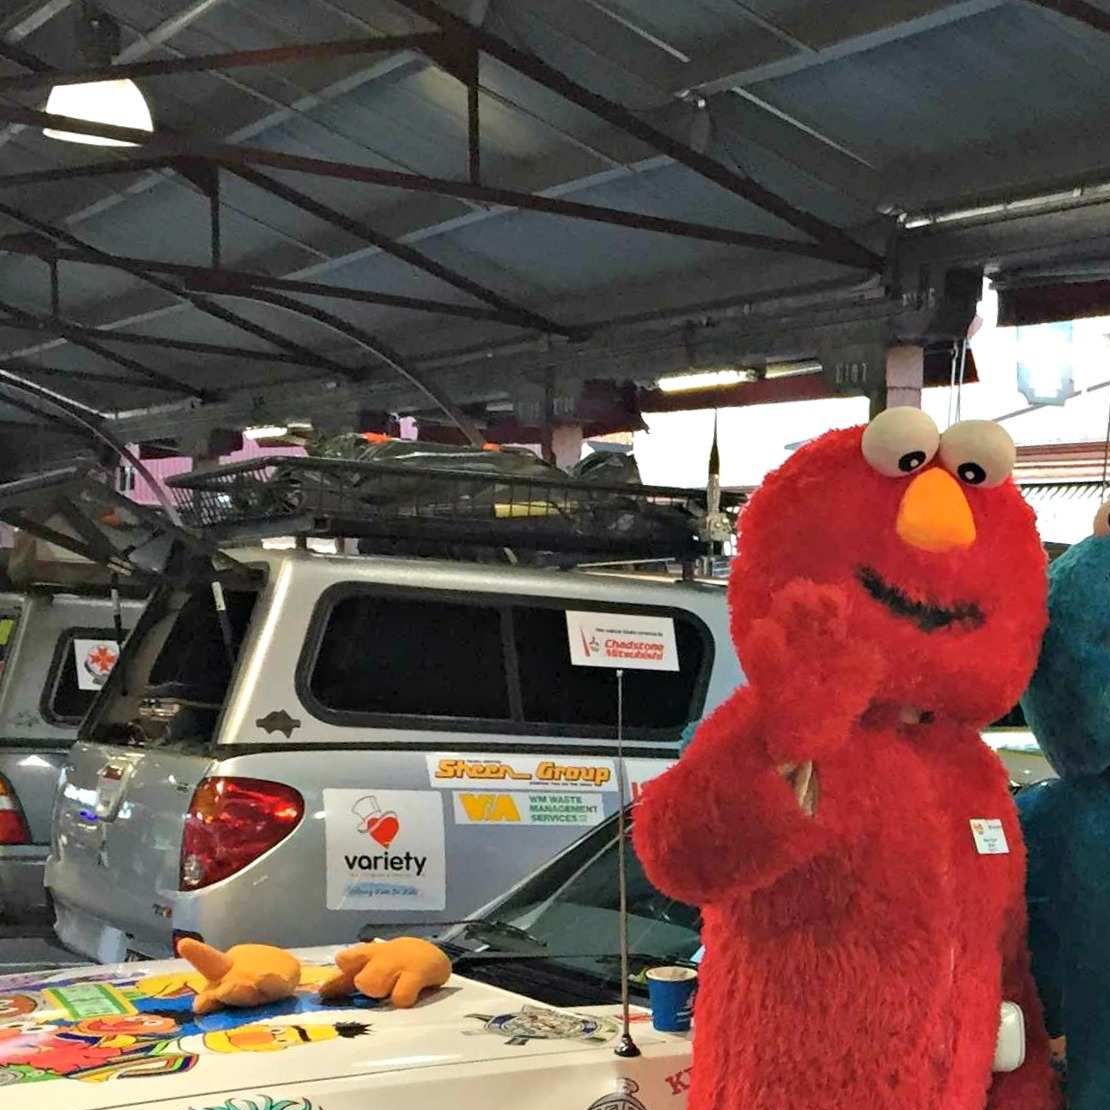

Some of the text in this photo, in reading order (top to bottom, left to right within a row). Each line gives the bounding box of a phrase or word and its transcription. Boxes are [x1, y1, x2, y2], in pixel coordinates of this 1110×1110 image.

[535, 761, 612, 787] Group
[549, 796, 583, 805] WASTE
[529, 805, 599, 814] MANAGEMENT
[531, 814, 578, 823] SERVICES
[344, 851, 428, 877] variety
